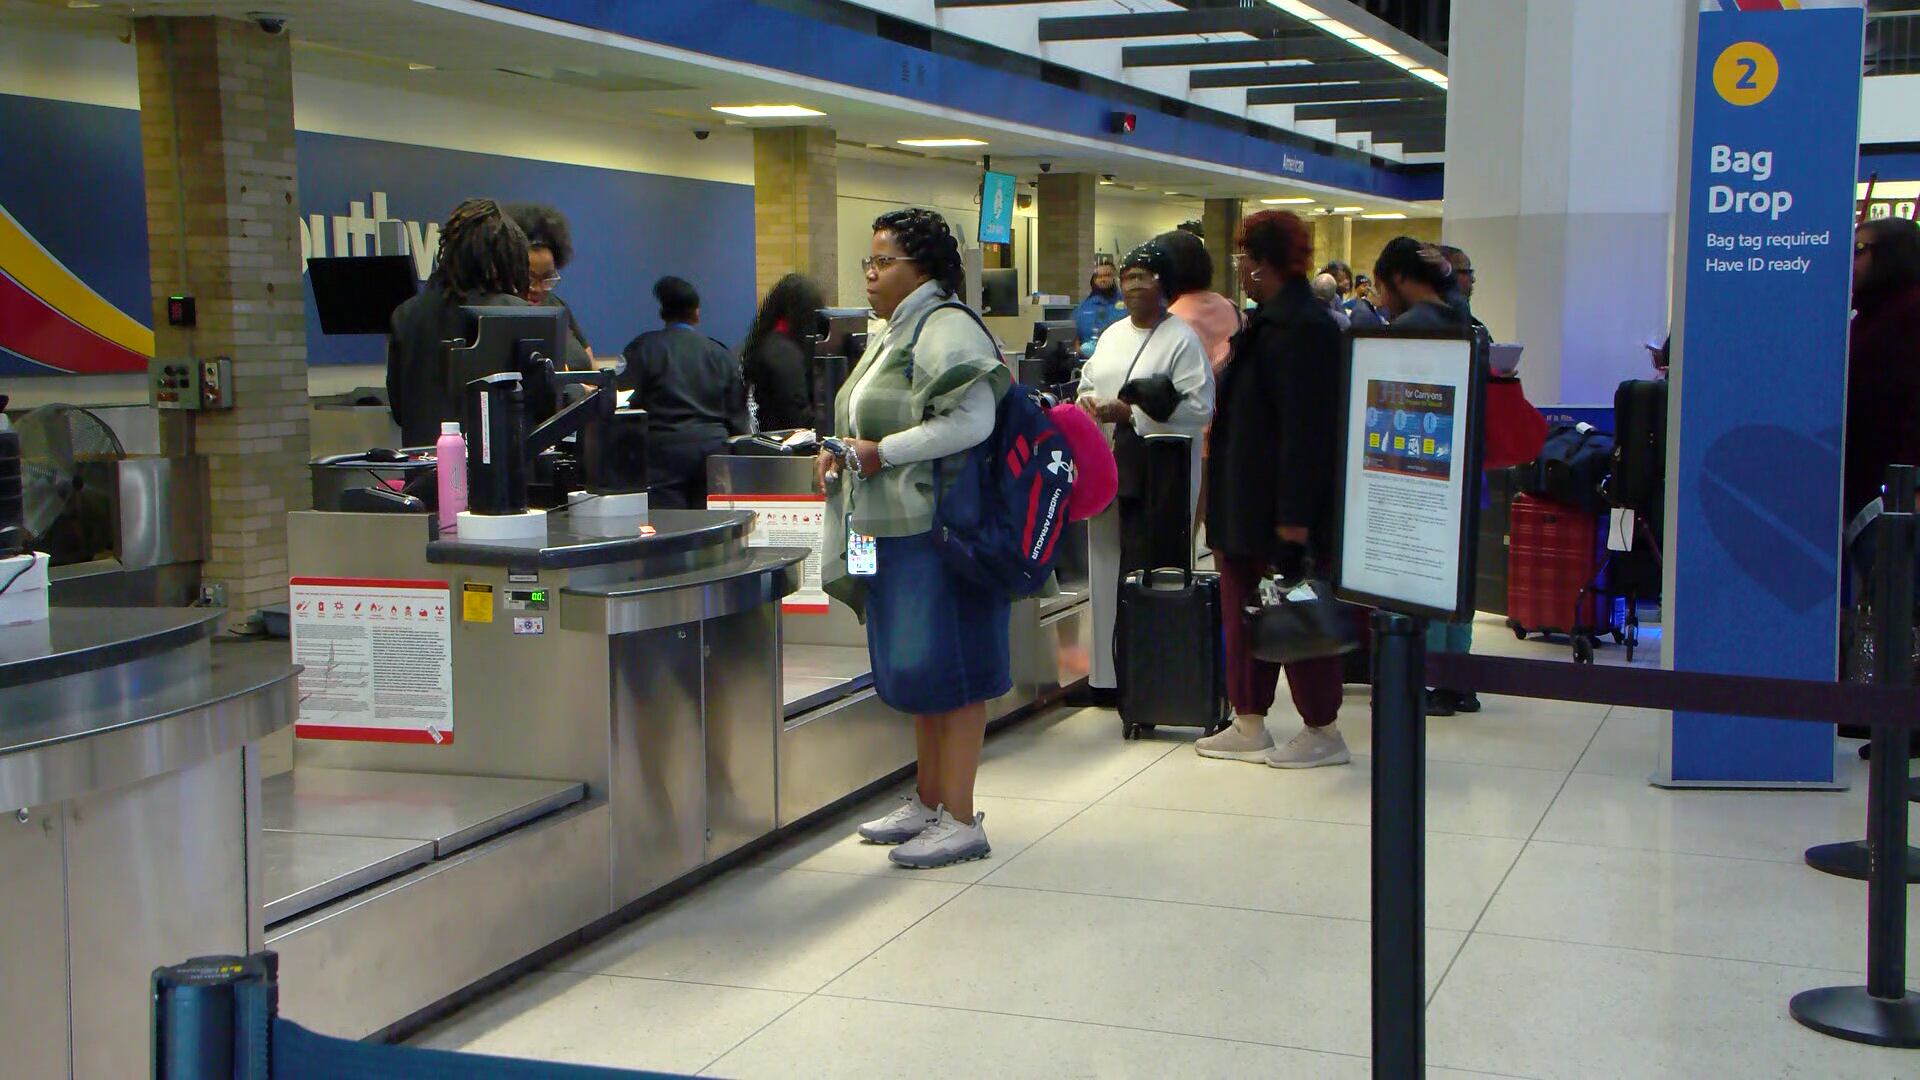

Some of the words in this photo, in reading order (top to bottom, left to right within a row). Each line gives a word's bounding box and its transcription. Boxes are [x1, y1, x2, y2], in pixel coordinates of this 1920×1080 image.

[1735, 57, 1758, 90] 2
[1710, 144, 1773, 182] Bag
[1708, 184, 1793, 221] Drop
[1706, 233, 1735, 251] Bag
[1738, 233, 1762, 251] tag
[1766, 230, 1830, 250] required
[1705, 258, 1744, 272] Have
[1747, 257, 1764, 272] ID
[1768, 256, 1811, 274] ready
[1047, 488, 1062, 519] UNDER
[1031, 519, 1050, 560] ARMOUR
